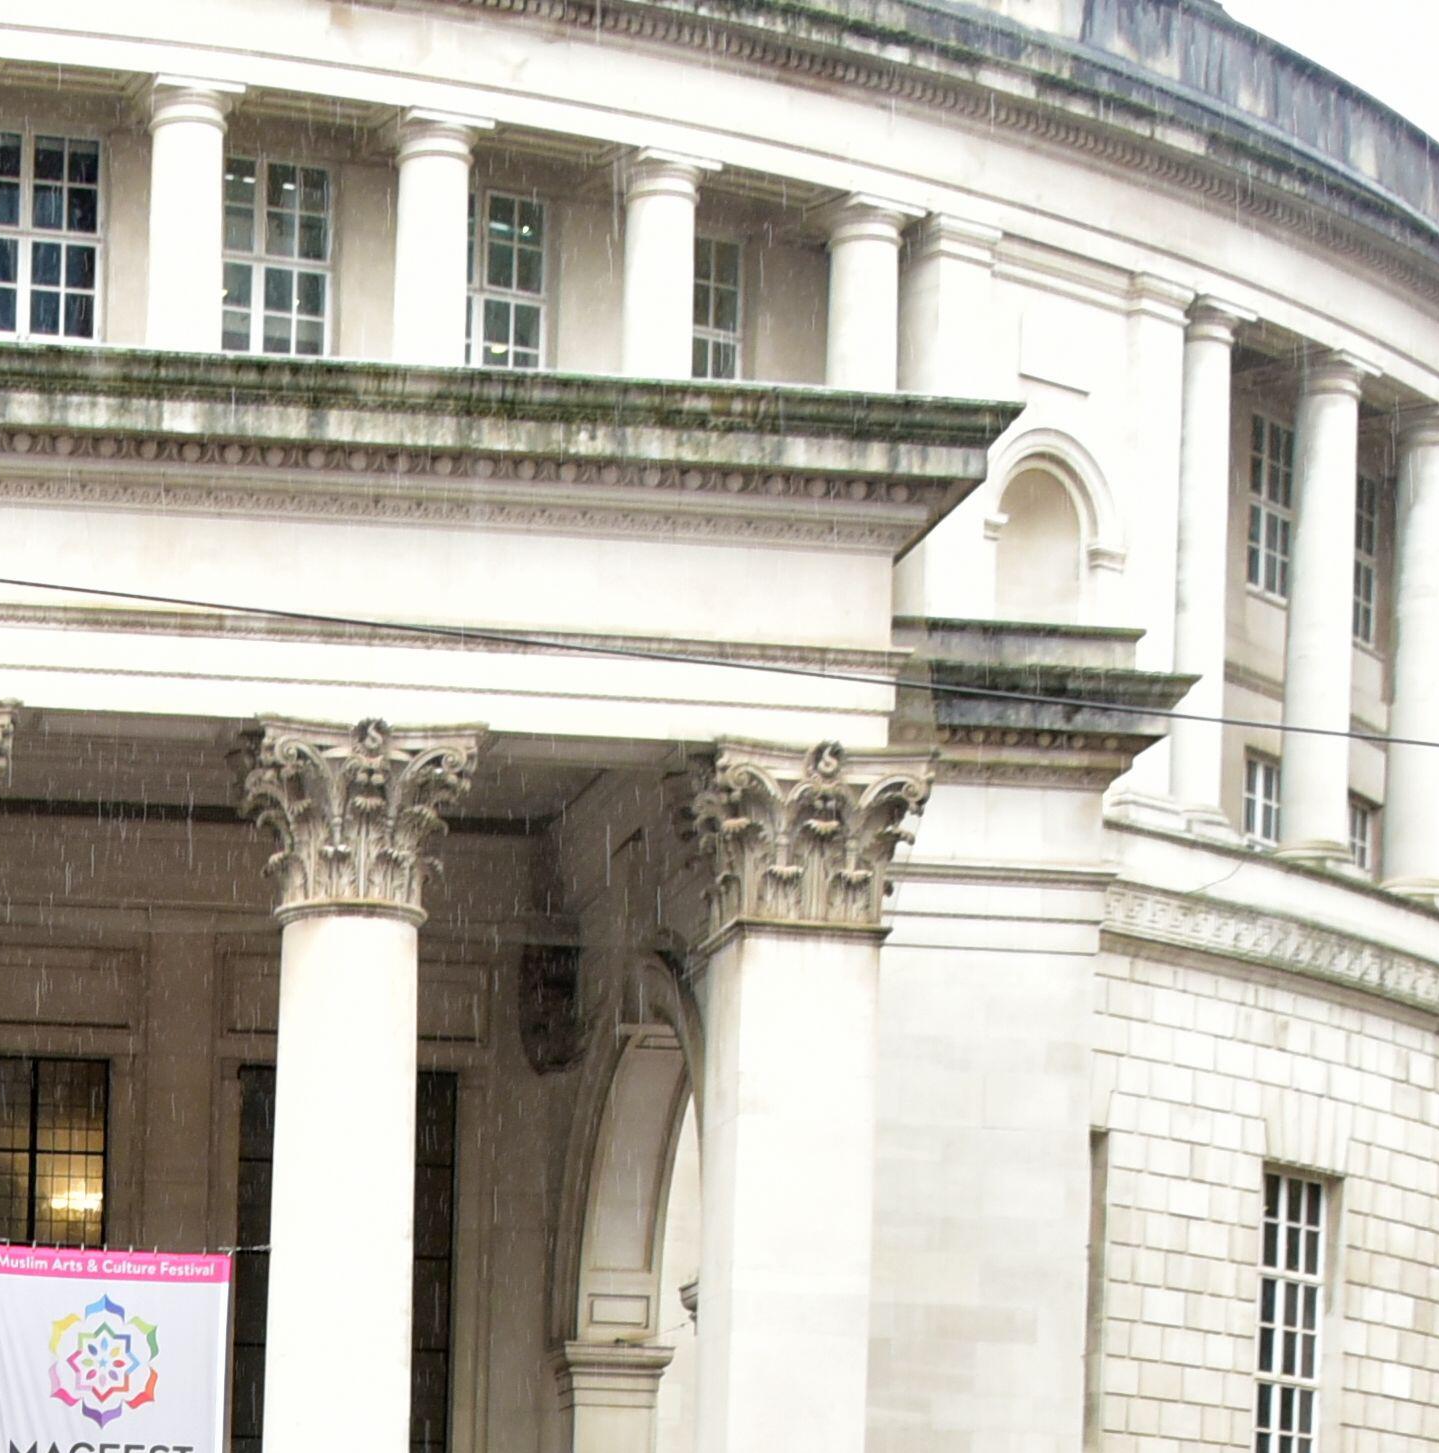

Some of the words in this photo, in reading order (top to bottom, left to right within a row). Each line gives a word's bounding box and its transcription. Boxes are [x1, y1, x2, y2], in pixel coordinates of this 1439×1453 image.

[52, 1258, 83, 1272] Arts
[87, 1260, 98, 1273] &
[102, 1259, 156, 1275] Culture
[160, 1262, 215, 1276] Festival
